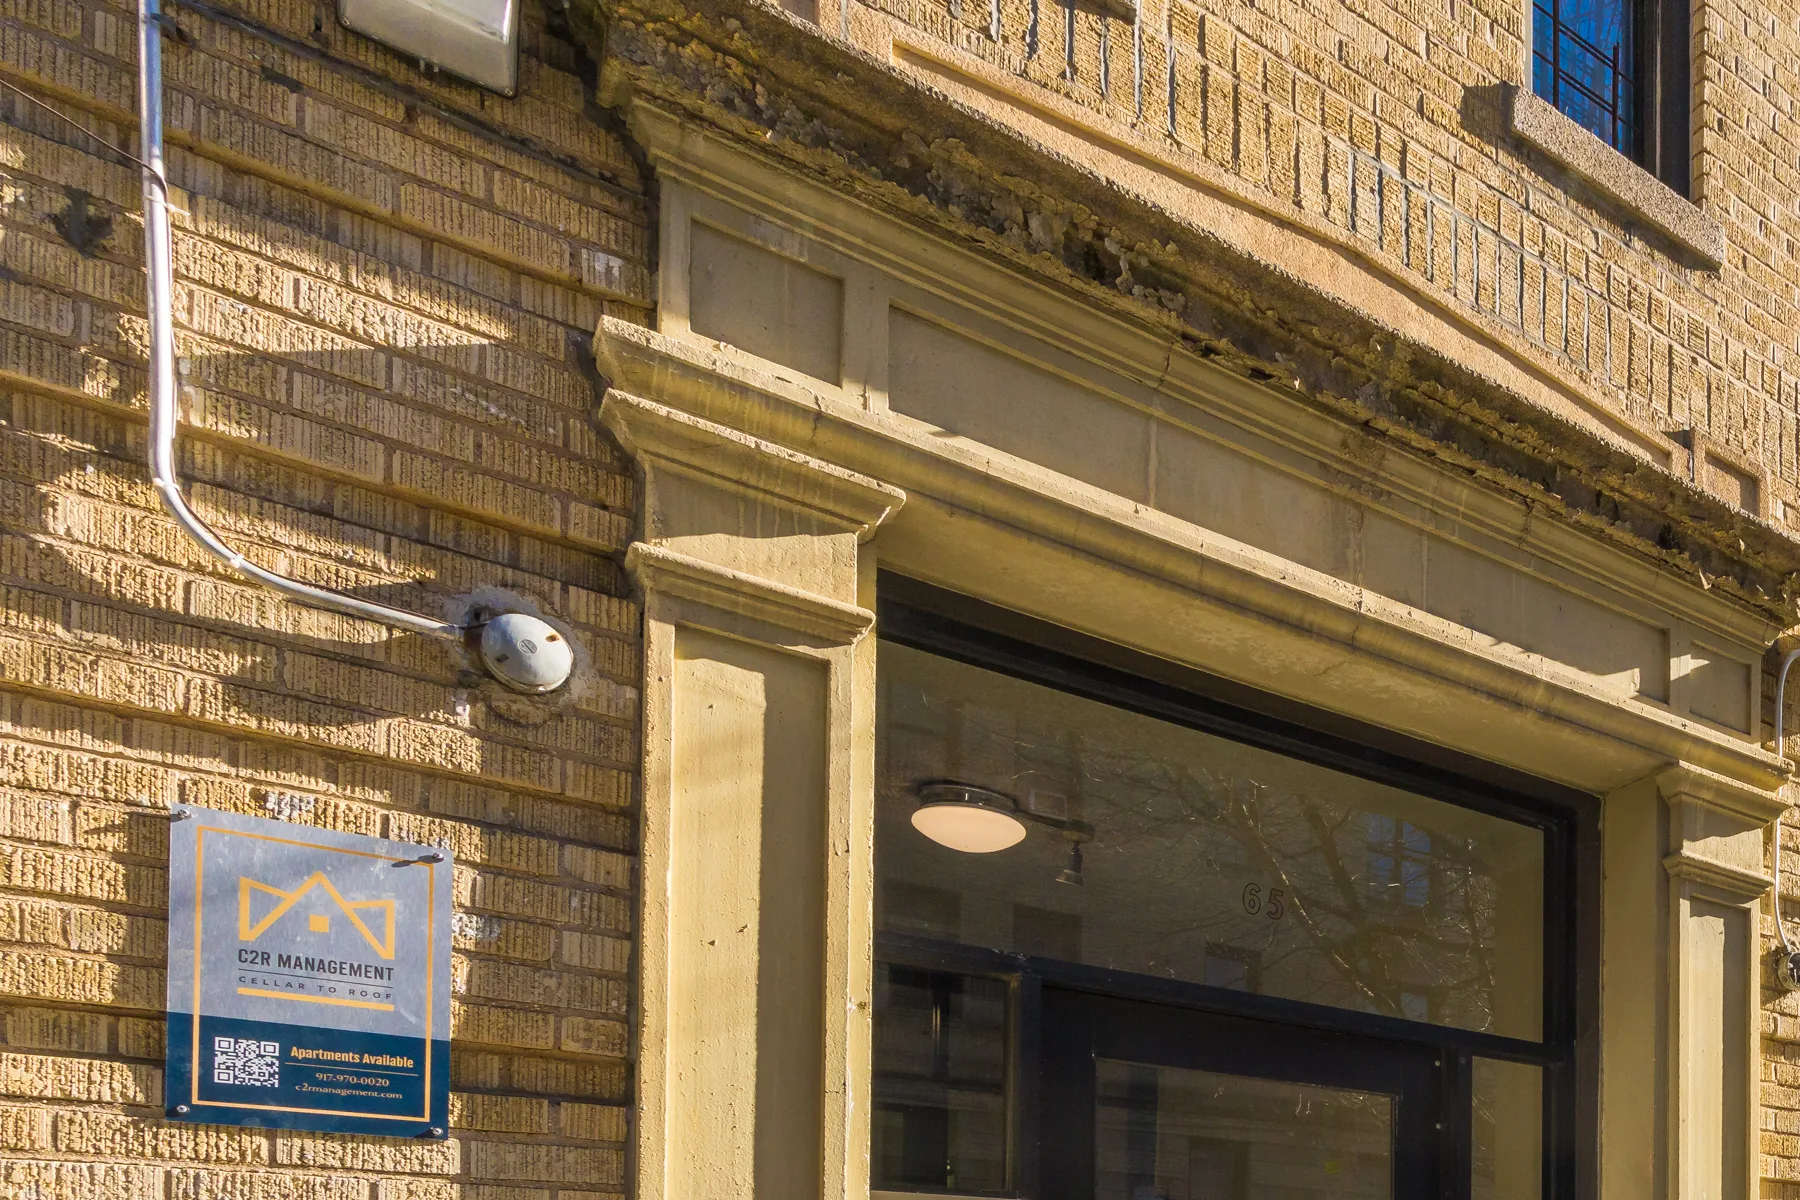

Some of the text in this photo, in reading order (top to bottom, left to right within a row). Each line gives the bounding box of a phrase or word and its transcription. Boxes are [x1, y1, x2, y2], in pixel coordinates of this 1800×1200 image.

[1242, 882, 1284, 920] 65
[238, 948, 394, 981] C2R MANAGEMENT
[238, 976, 392, 1000] CELLAR TO ROOF
[290, 1046, 414, 1068] Apartments Available
[295, 1082, 403, 1099] c2rmanagement.com
[315, 1072, 390, 1087] 917-970-0020
